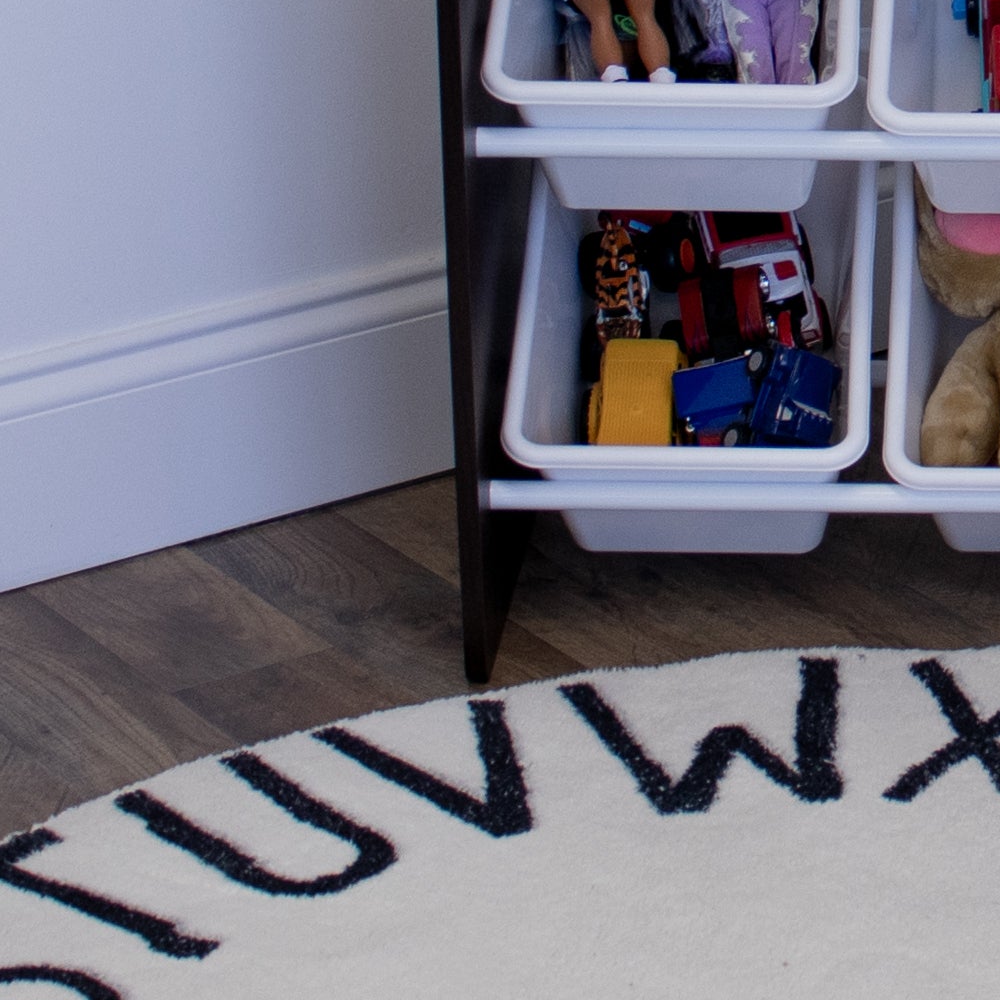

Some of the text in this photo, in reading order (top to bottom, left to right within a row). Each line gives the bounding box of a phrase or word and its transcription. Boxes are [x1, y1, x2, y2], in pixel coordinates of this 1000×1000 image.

[114, 749, 399, 897] U
[310, 698, 534, 838] V
[557, 656, 845, 816] W
